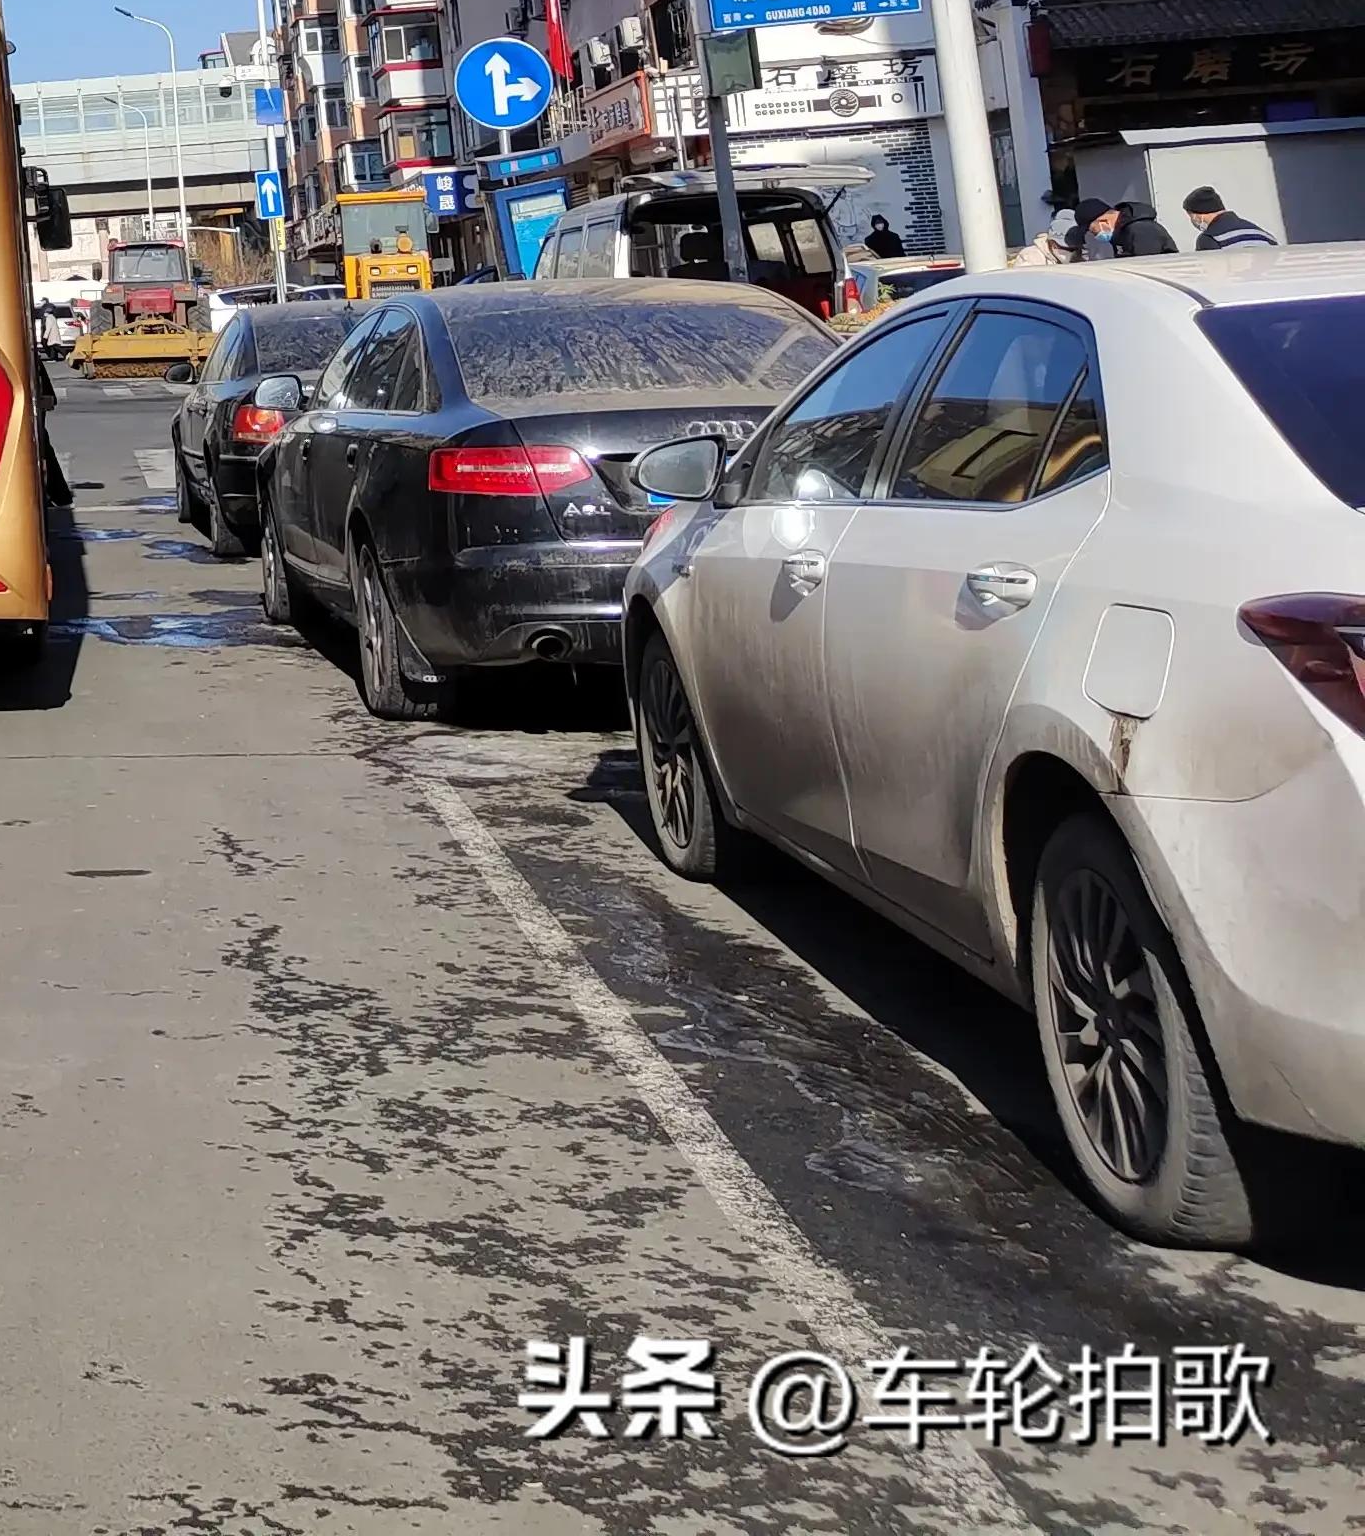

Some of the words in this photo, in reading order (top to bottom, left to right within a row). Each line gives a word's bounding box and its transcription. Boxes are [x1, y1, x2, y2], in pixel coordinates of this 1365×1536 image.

[851, 1, 868, 12] JIE
[765, 56, 924, 87] 石磨坊
[1104, 43, 1315, 88] 石磨坊
